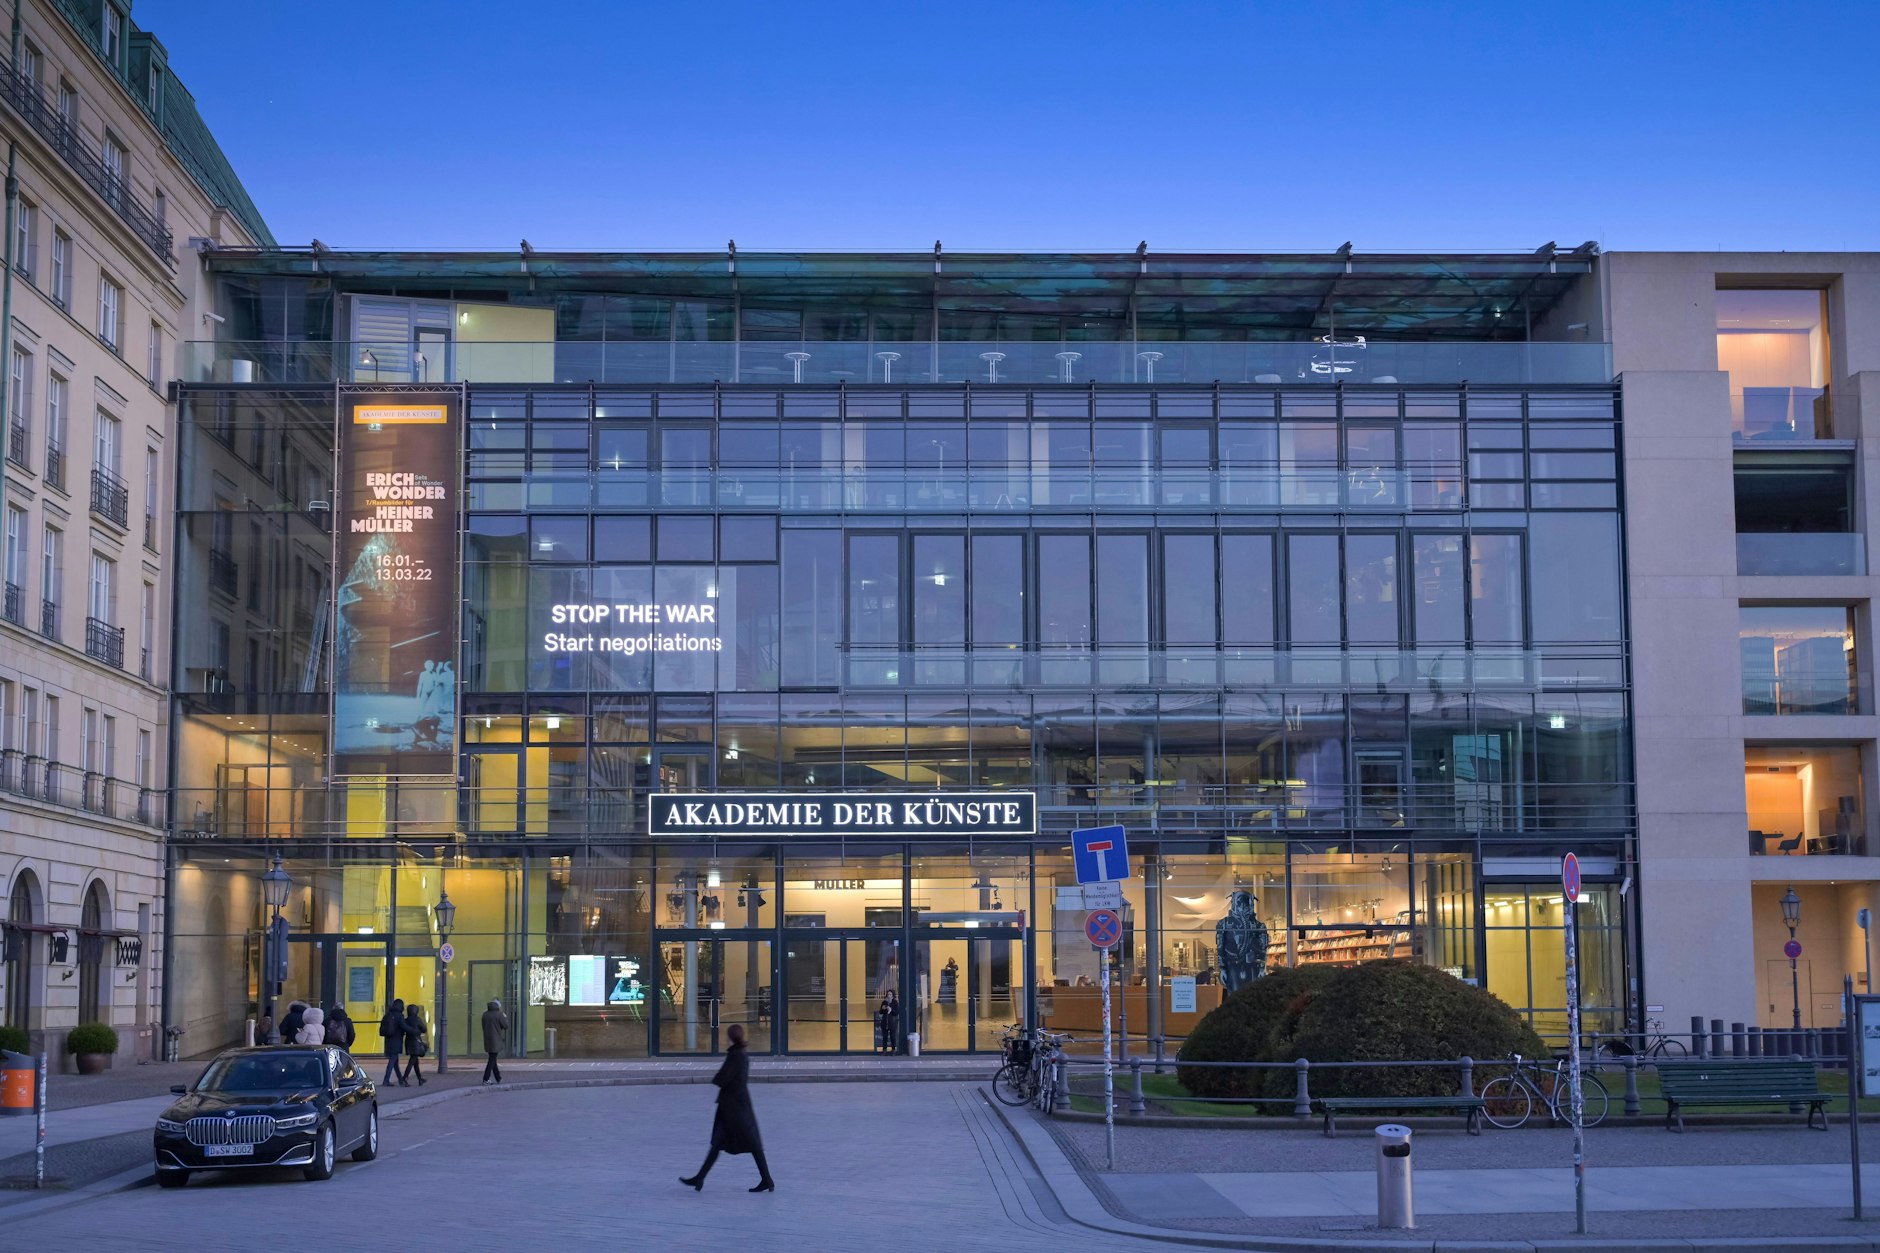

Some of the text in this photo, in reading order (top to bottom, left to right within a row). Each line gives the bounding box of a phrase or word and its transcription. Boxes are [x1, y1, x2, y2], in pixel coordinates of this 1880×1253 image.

[366, 473, 414, 486] ERICH
[373, 486, 446, 500] WONDER
[376, 506, 434, 519] HEINER
[351, 517, 414, 533] MÜLLER
[376, 568, 432, 580] 13.03.22
[551, 604, 715, 623] STOP THE WAR
[544, 633, 722, 656] Start negotiations
[664, 798, 1021, 826] AKADEMIE DER KÜNSTE
[232, 1145, 252, 1154] 3002
